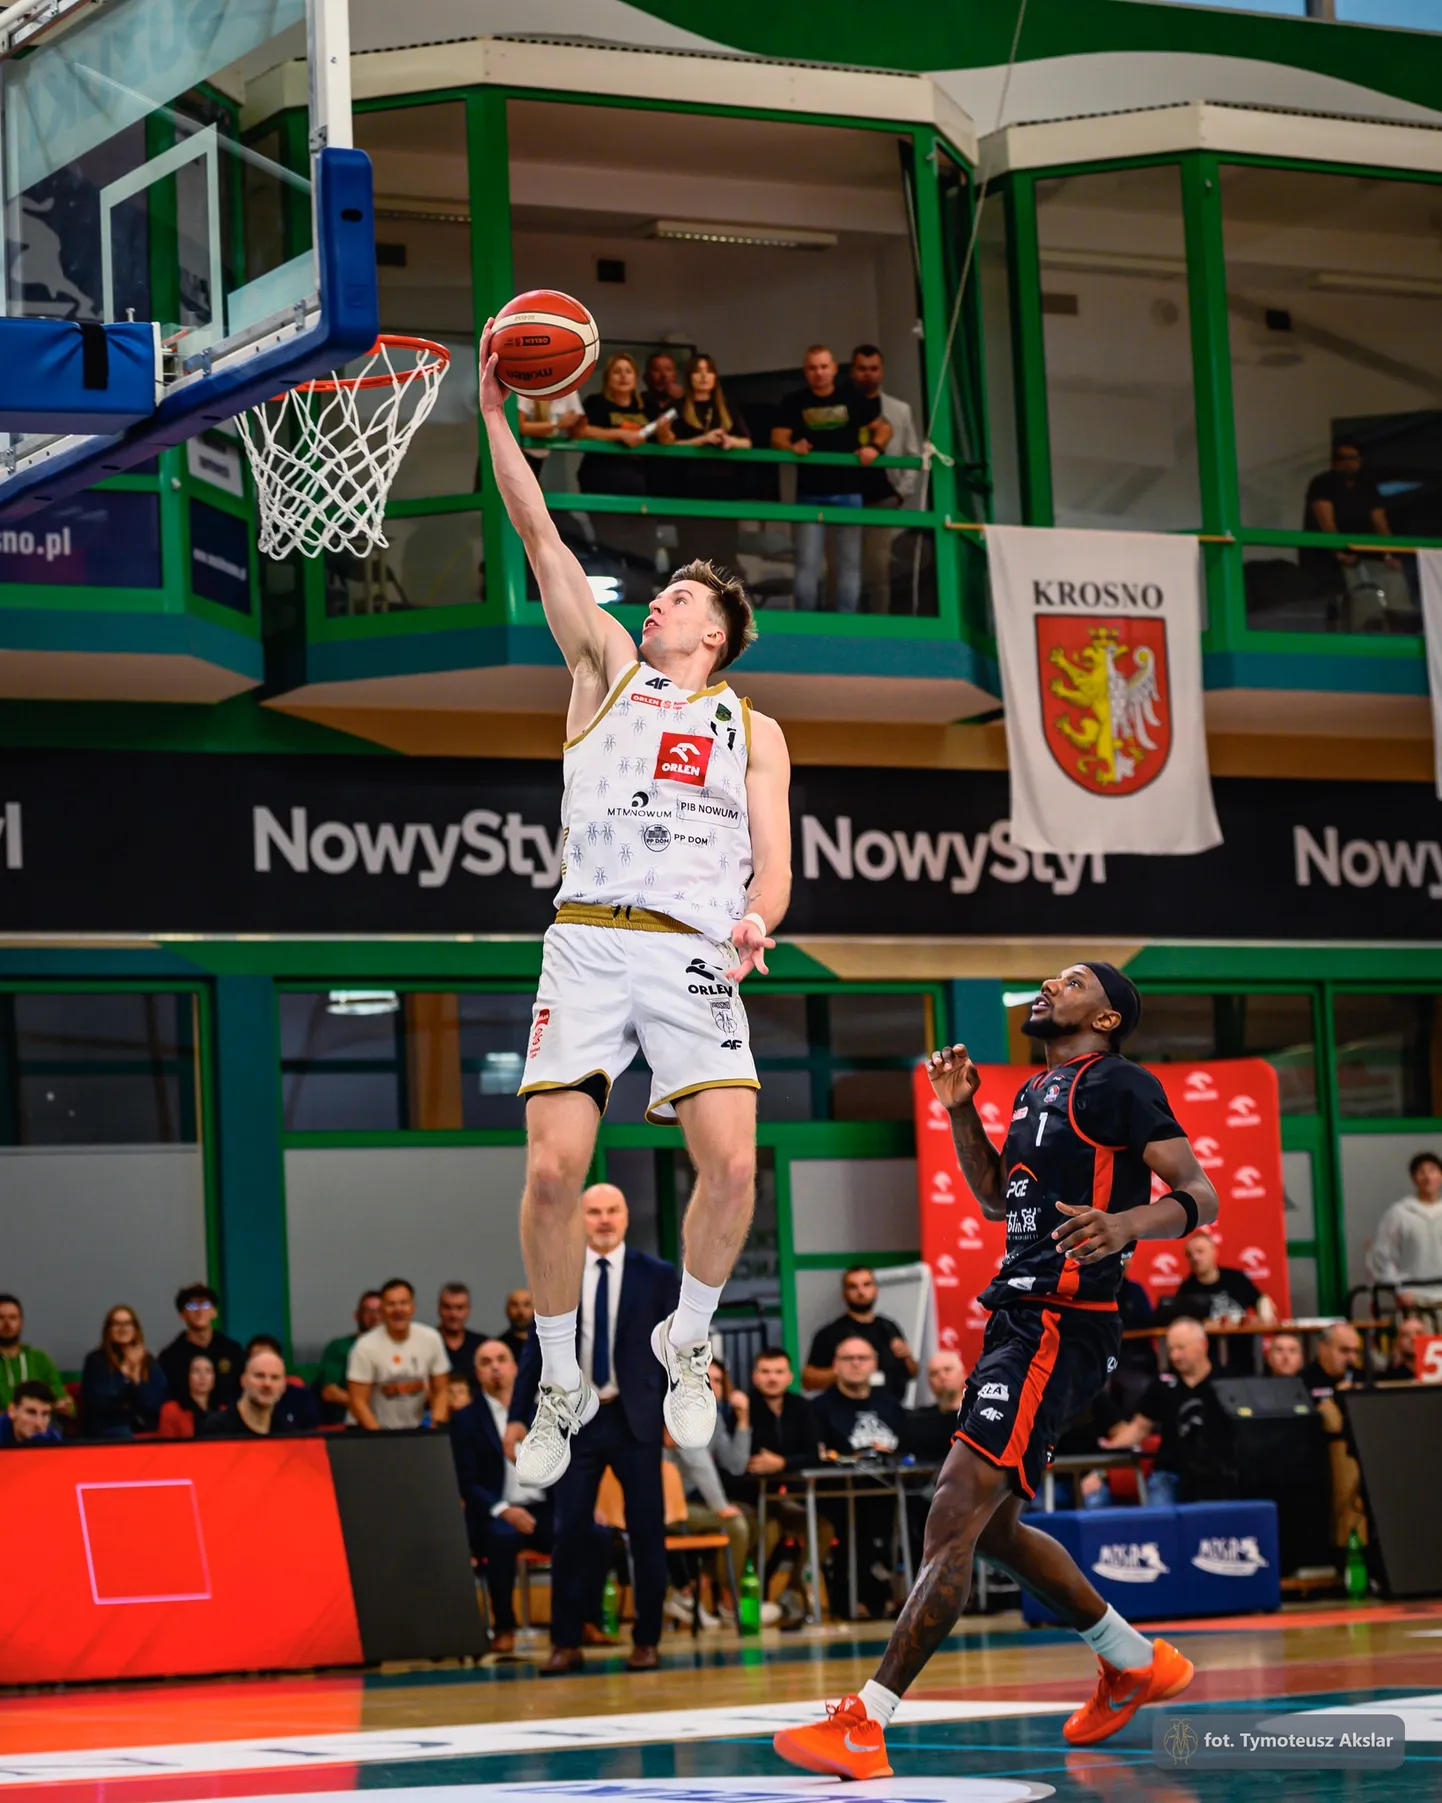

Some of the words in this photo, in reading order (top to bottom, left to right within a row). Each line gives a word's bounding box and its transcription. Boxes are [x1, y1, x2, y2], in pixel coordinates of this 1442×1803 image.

[0, 526, 71, 562] no.pl
[1032, 579, 1164, 611] KROSNO
[645, 677, 672, 690] 4F
[633, 695, 660, 706] ORLEN
[661, 762, 701, 777] ORLEN
[680, 802, 696, 811] PIB
[698, 804, 739, 820] NOWUM
[674, 833, 686, 842] PP
[688, 835, 708, 846] DOM
[720, 1039, 743, 1051] 4F
[1036, 1111, 1049, 1147] 1
[1006, 1179, 1029, 1198] PGE
[1422, 1340, 1442, 1383] 5
[980, 1406, 1005, 1422] 4F
